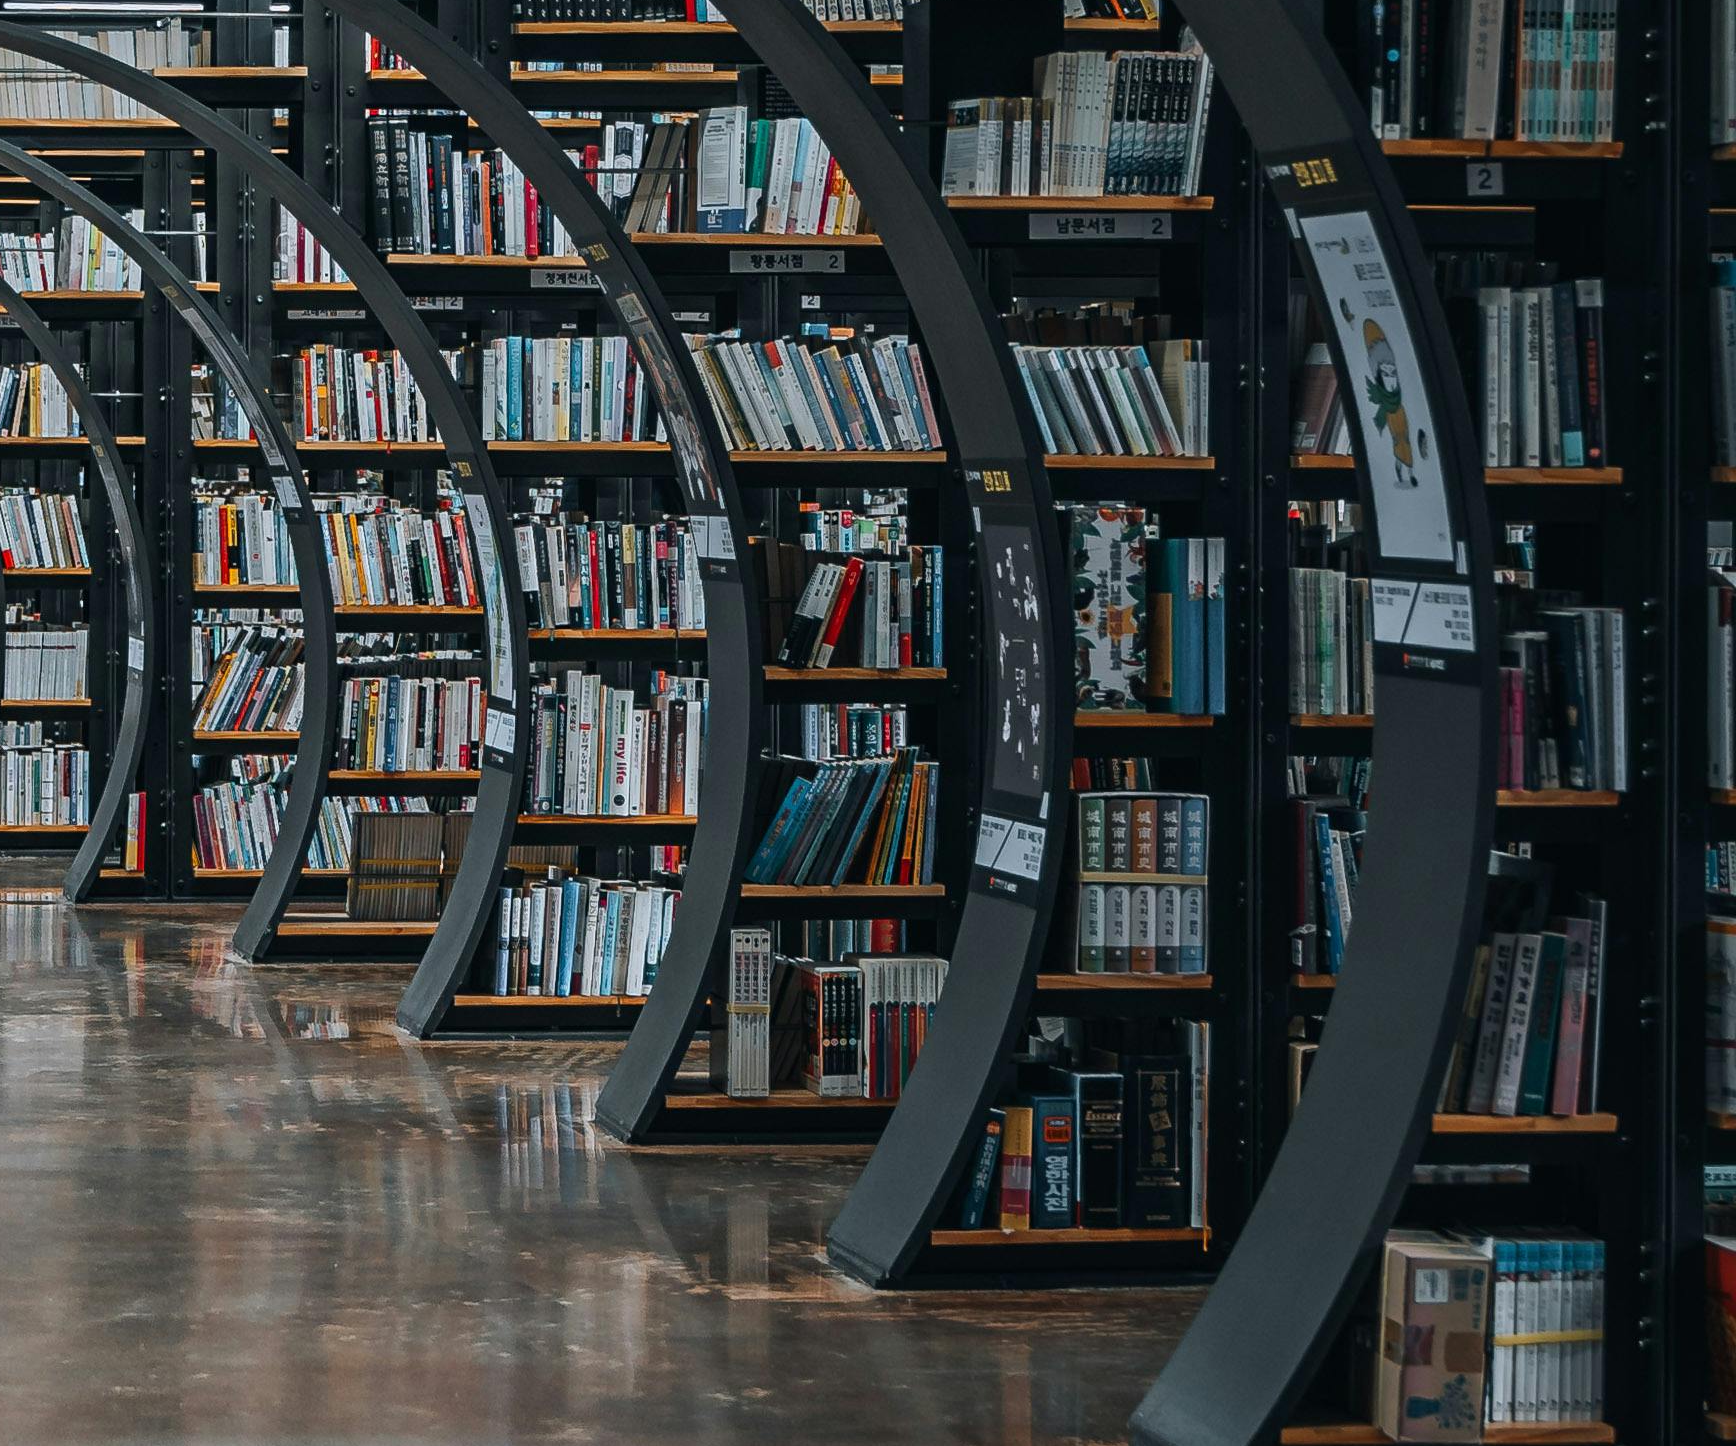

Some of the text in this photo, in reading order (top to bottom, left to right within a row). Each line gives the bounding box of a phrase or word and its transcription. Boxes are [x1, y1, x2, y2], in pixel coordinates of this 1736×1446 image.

[1477, 168, 1492, 190] 2
[1056, 217, 1163, 235] 남문서점 2
[751, 255, 839, 270] 황룡서점 2
[615, 737, 628, 785] my life
[1086, 810, 1101, 869] 城南市史
[1111, 810, 1127, 869] 城南市史
[1136, 810, 1152, 869] 城南市史
[1163, 810, 1178, 869] 城南市史
[1187, 810, 1202, 869] 城南市史
[1044, 1154, 1070, 1212] 영한사전
